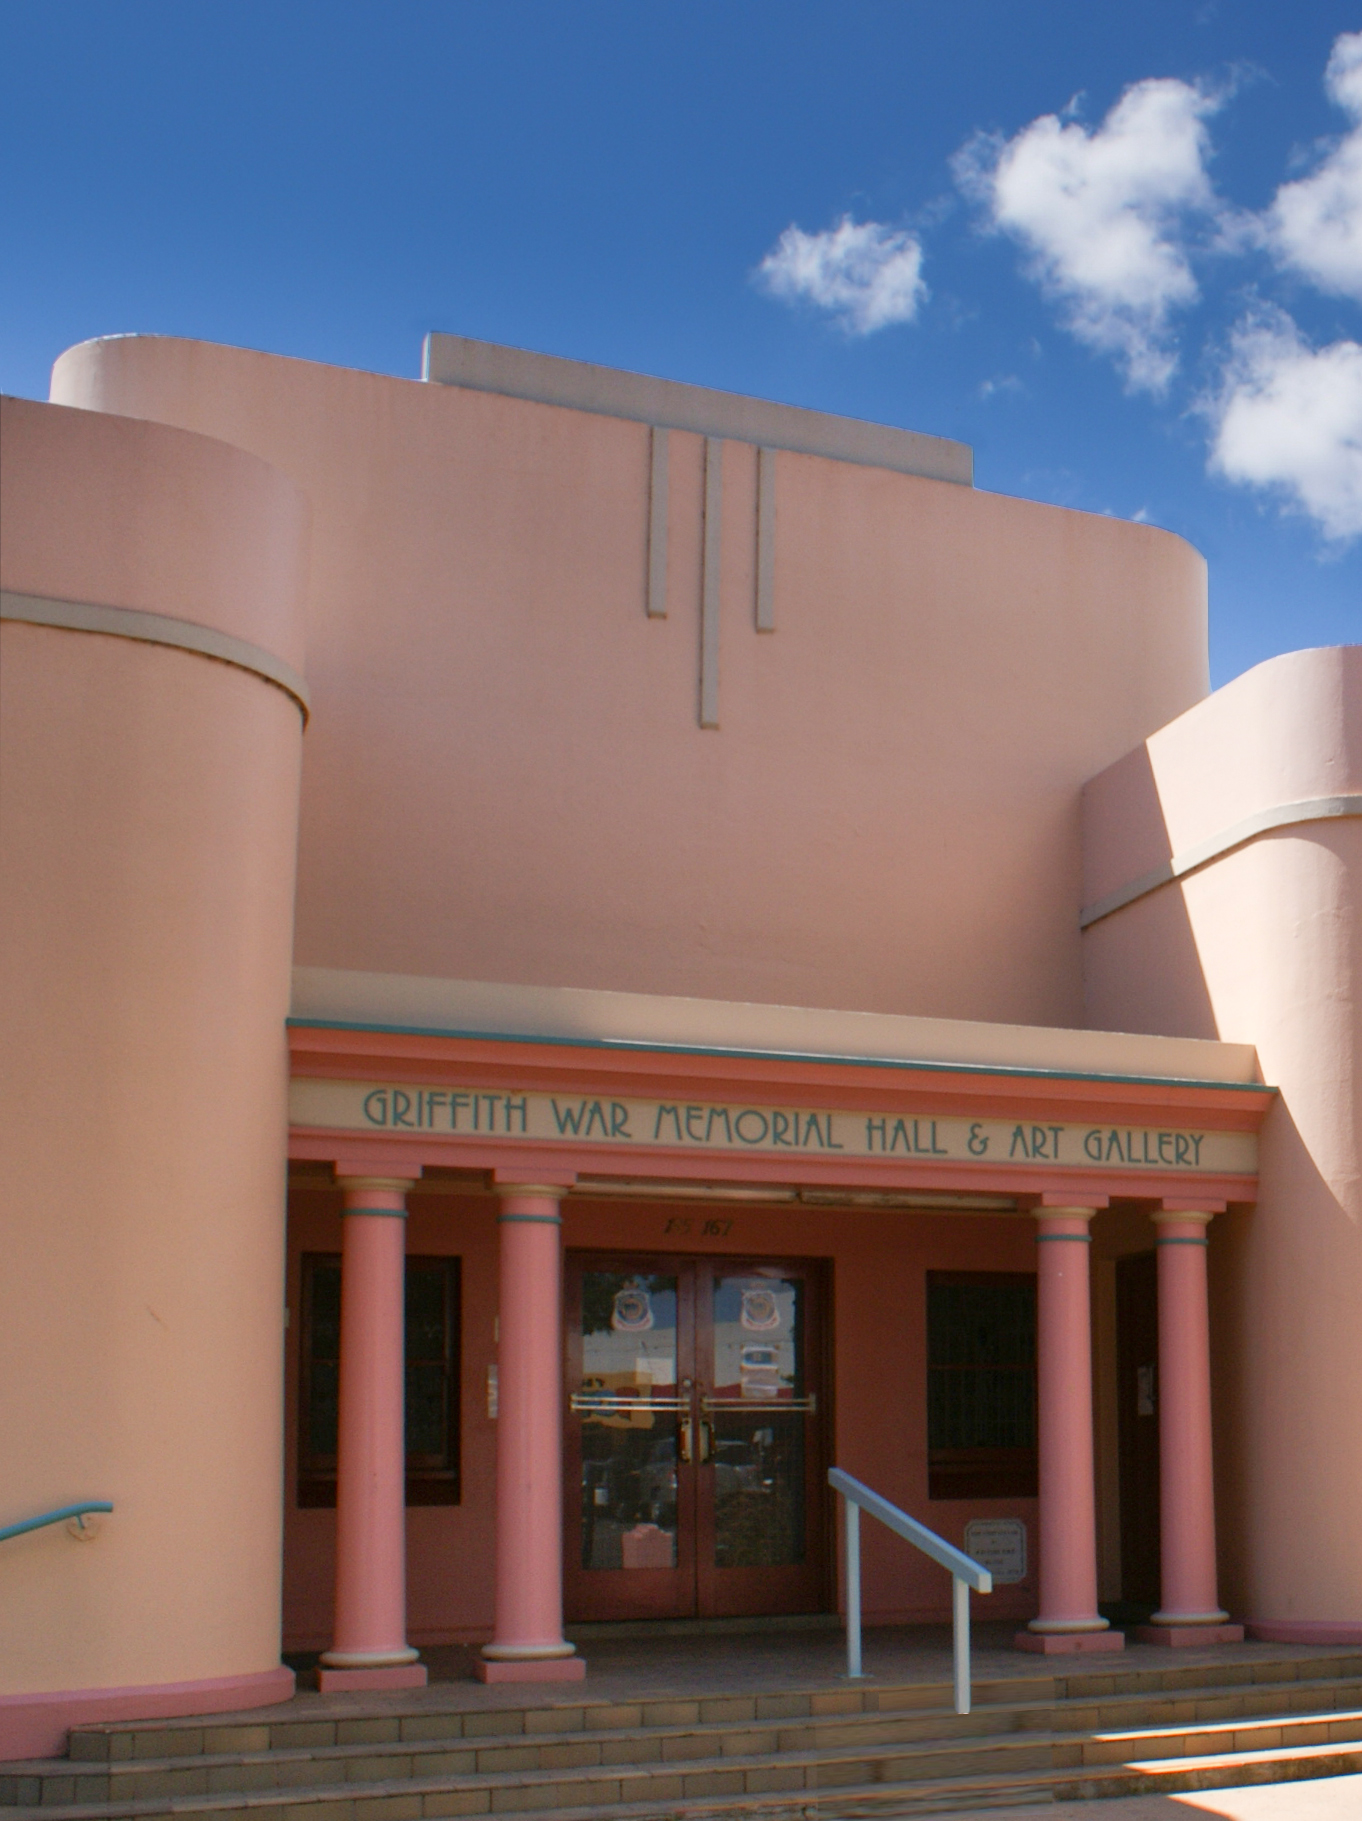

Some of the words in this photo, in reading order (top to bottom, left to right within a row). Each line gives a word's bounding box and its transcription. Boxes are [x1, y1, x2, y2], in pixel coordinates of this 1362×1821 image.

[363, 1087, 527, 1133] GRIFFITH
[550, 1098, 632, 1139] WAR
[653, 1103, 844, 1149] MEMORIAL
[866, 1117, 948, 1155] HALL
[967, 1123, 990, 1156] &
[1009, 1124, 1065, 1160] ART
[1083, 1129, 1205, 1167] GALLERY
